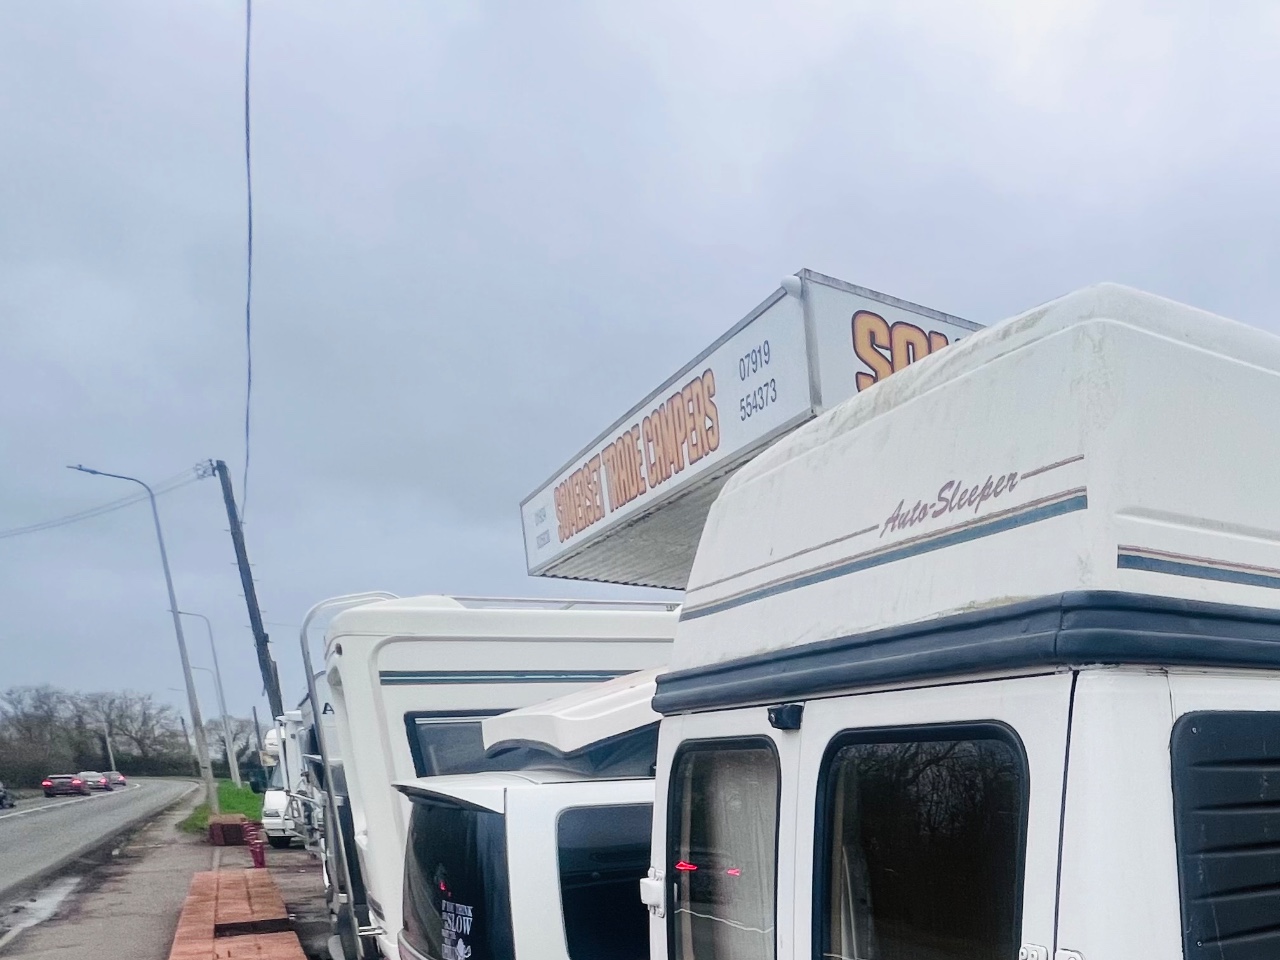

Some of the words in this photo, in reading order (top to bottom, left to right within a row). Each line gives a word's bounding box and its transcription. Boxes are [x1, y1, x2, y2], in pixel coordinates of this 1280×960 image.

[739, 339, 771, 382] 07919
[739, 378, 778, 422] 554373
[553, 453, 606, 544] SOMERSET
[602, 423, 647, 513] TRADE
[641, 367, 721, 489] CAMPERS
[879, 471, 1019, 539] Auto-Sleeper
[447, 912, 473, 936] SLOW
